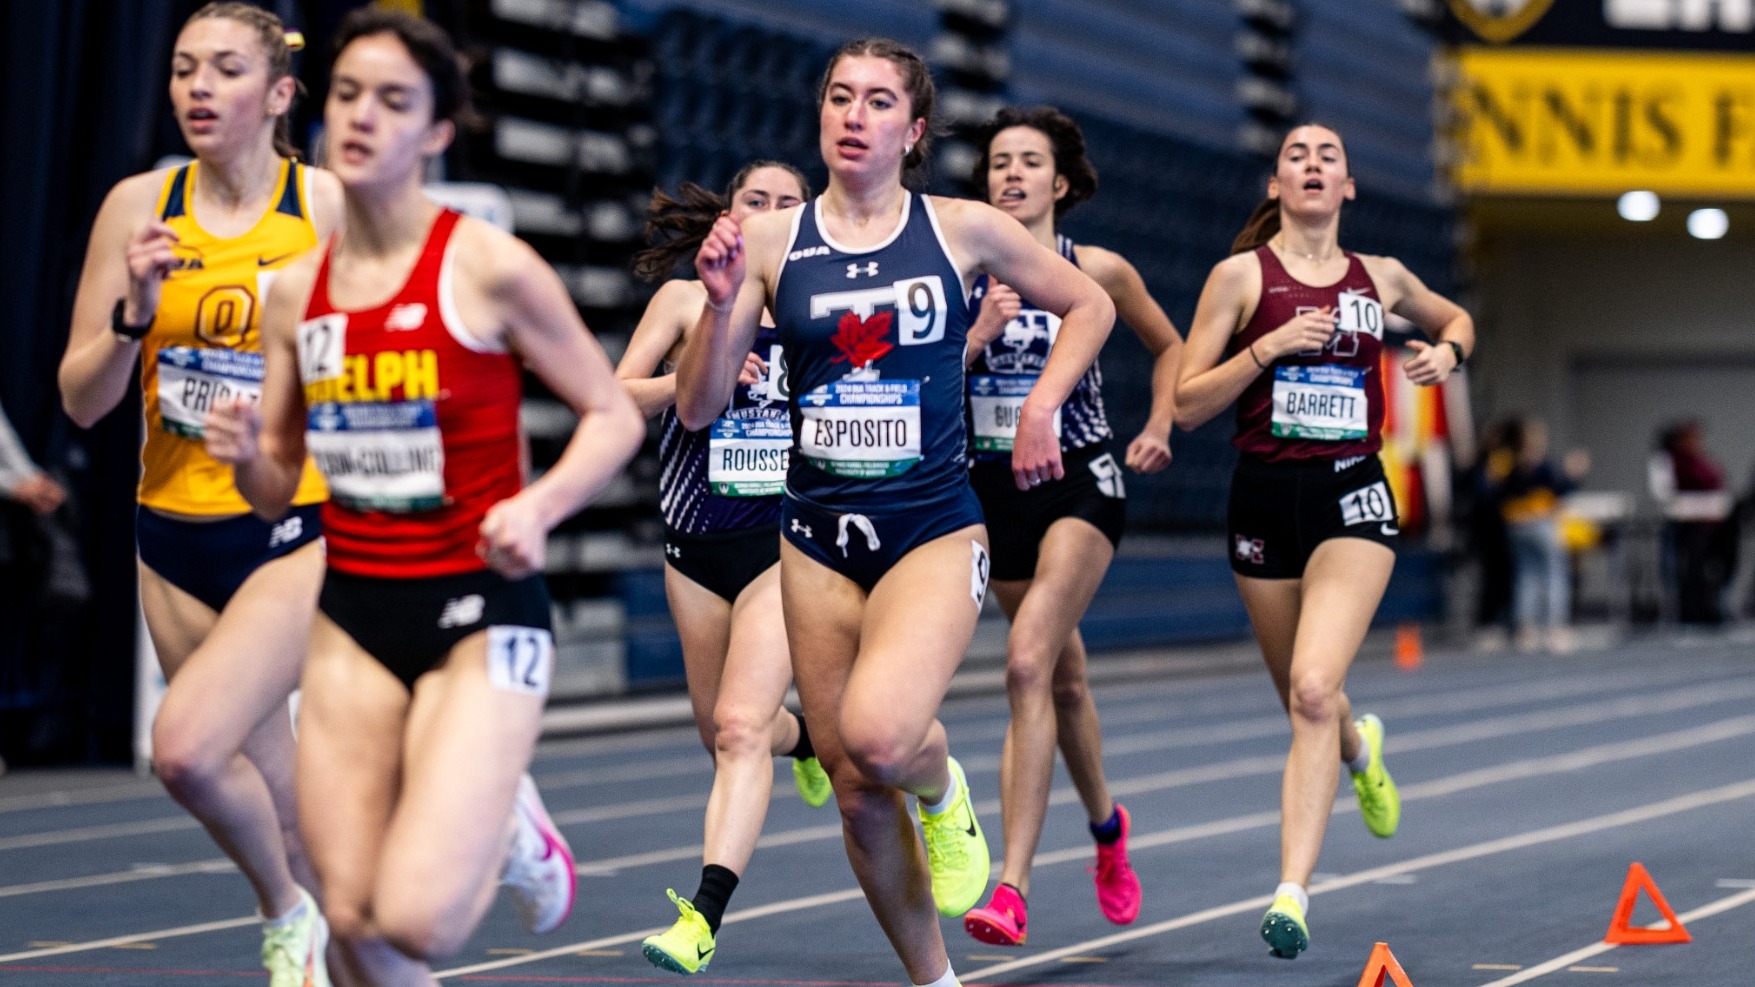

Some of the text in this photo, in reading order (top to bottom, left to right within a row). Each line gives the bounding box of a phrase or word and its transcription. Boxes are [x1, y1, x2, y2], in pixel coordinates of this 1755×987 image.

[789, 246, 831, 261] OUA
[907, 282, 936, 340] 9
[1350, 299, 1378, 333] 10
[1287, 391, 1357, 418] BARRETT
[814, 418, 907, 447] ESPOSITO
[722, 448, 788, 472] ROUSSE
[1352, 488, 1385, 519] 10
[502, 636, 542, 688] 12
